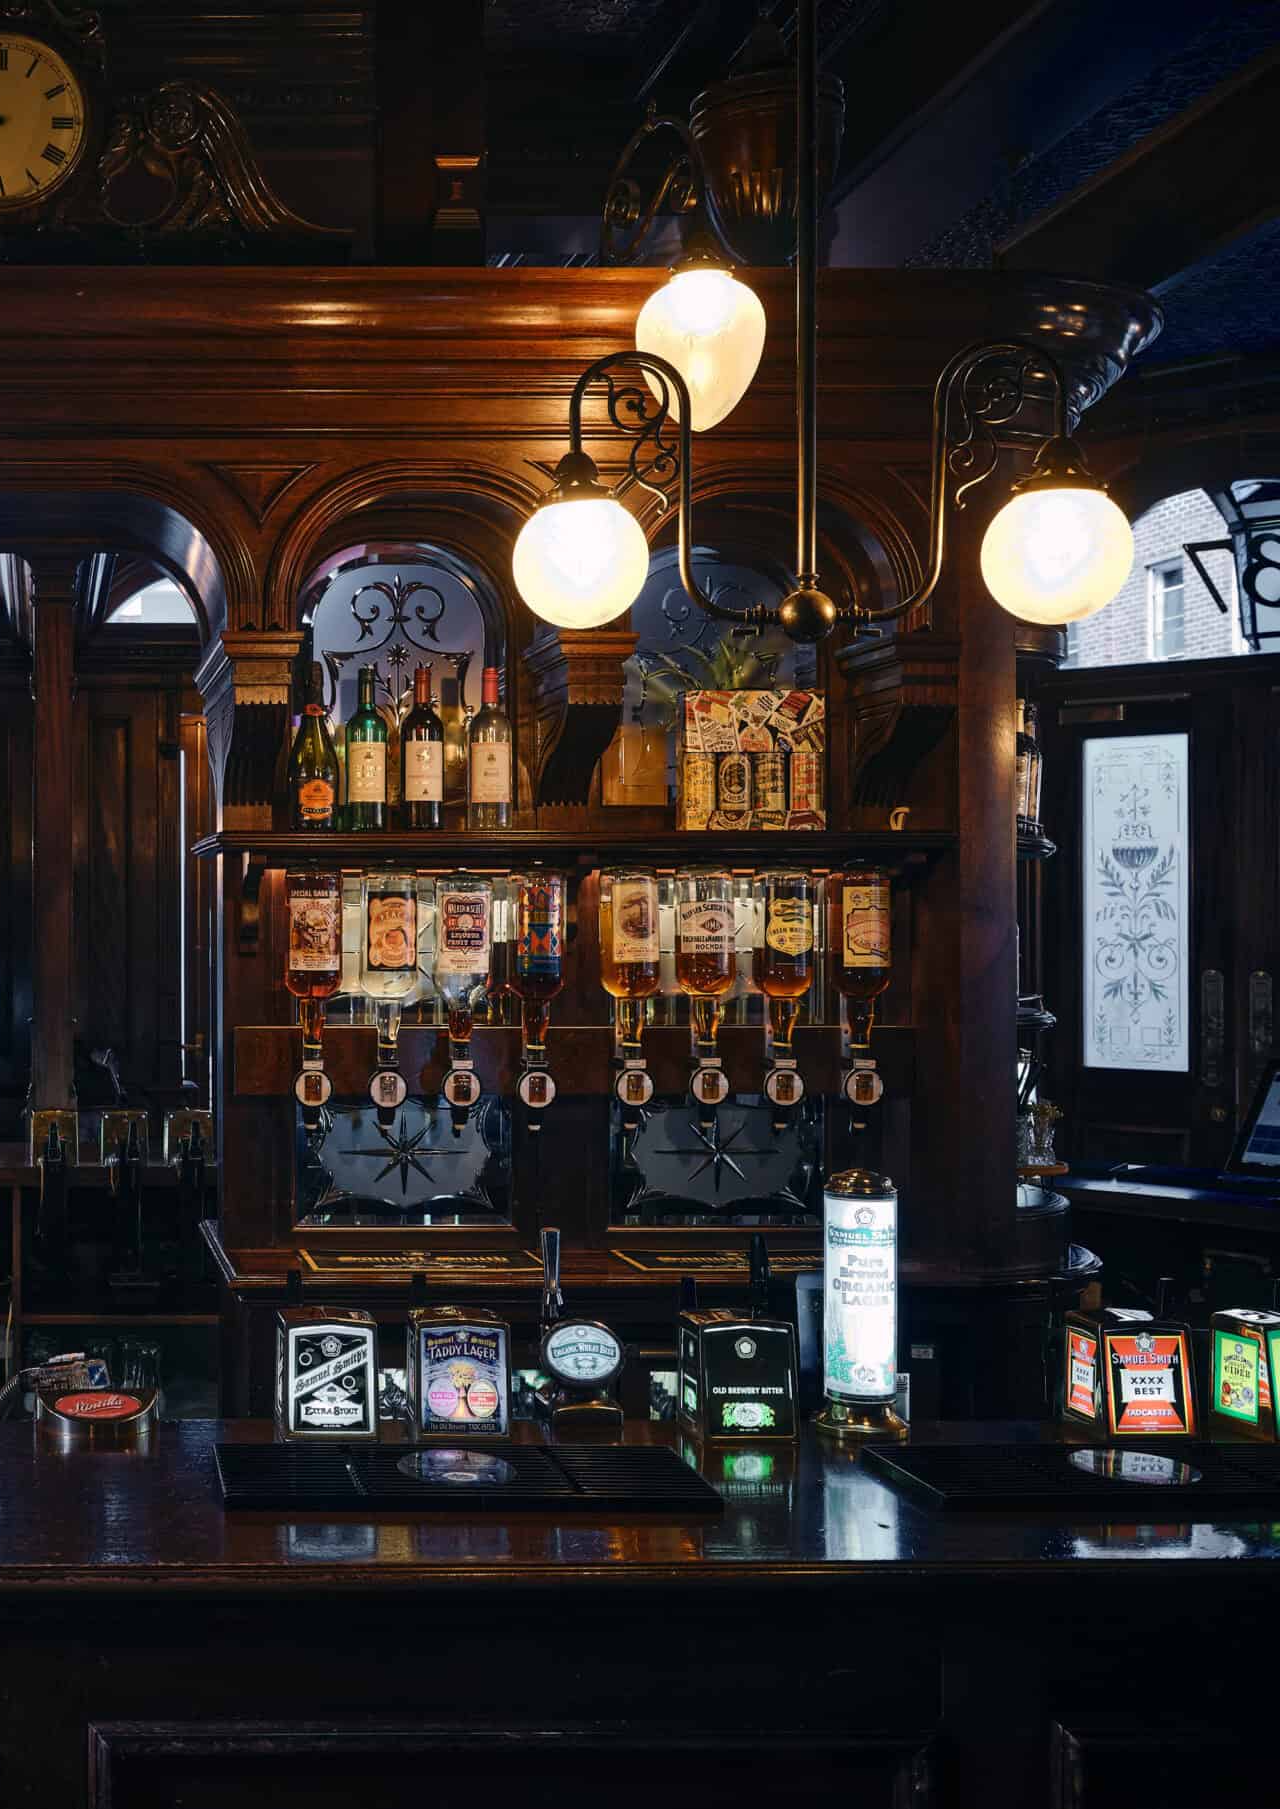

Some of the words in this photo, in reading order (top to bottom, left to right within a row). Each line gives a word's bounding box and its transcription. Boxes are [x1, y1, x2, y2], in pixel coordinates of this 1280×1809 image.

[429, 1343, 462, 1360] TADDY
[463, 1343, 497, 1360] LAGER
[600, 1345, 616, 1357] BEER
[1111, 1354, 1148, 1365] SAMUEL
[1150, 1354, 1179, 1365] SMITH
[1224, 1365, 1251, 1379] CIDER
[294, 1362, 331, 1394] Samuel
[1130, 1376, 1165, 1385] XXXX
[712, 1386, 727, 1395] OLD
[727, 1386, 761, 1395] BREWERY
[761, 1386, 784, 1395] BITTER
[1134, 1387, 1163, 1396] BEST
[303, 1406, 332, 1416] EXTRA
[333, 1405, 359, 1416] STOUT
[1127, 1408, 1174, 1417] TADCASTER
